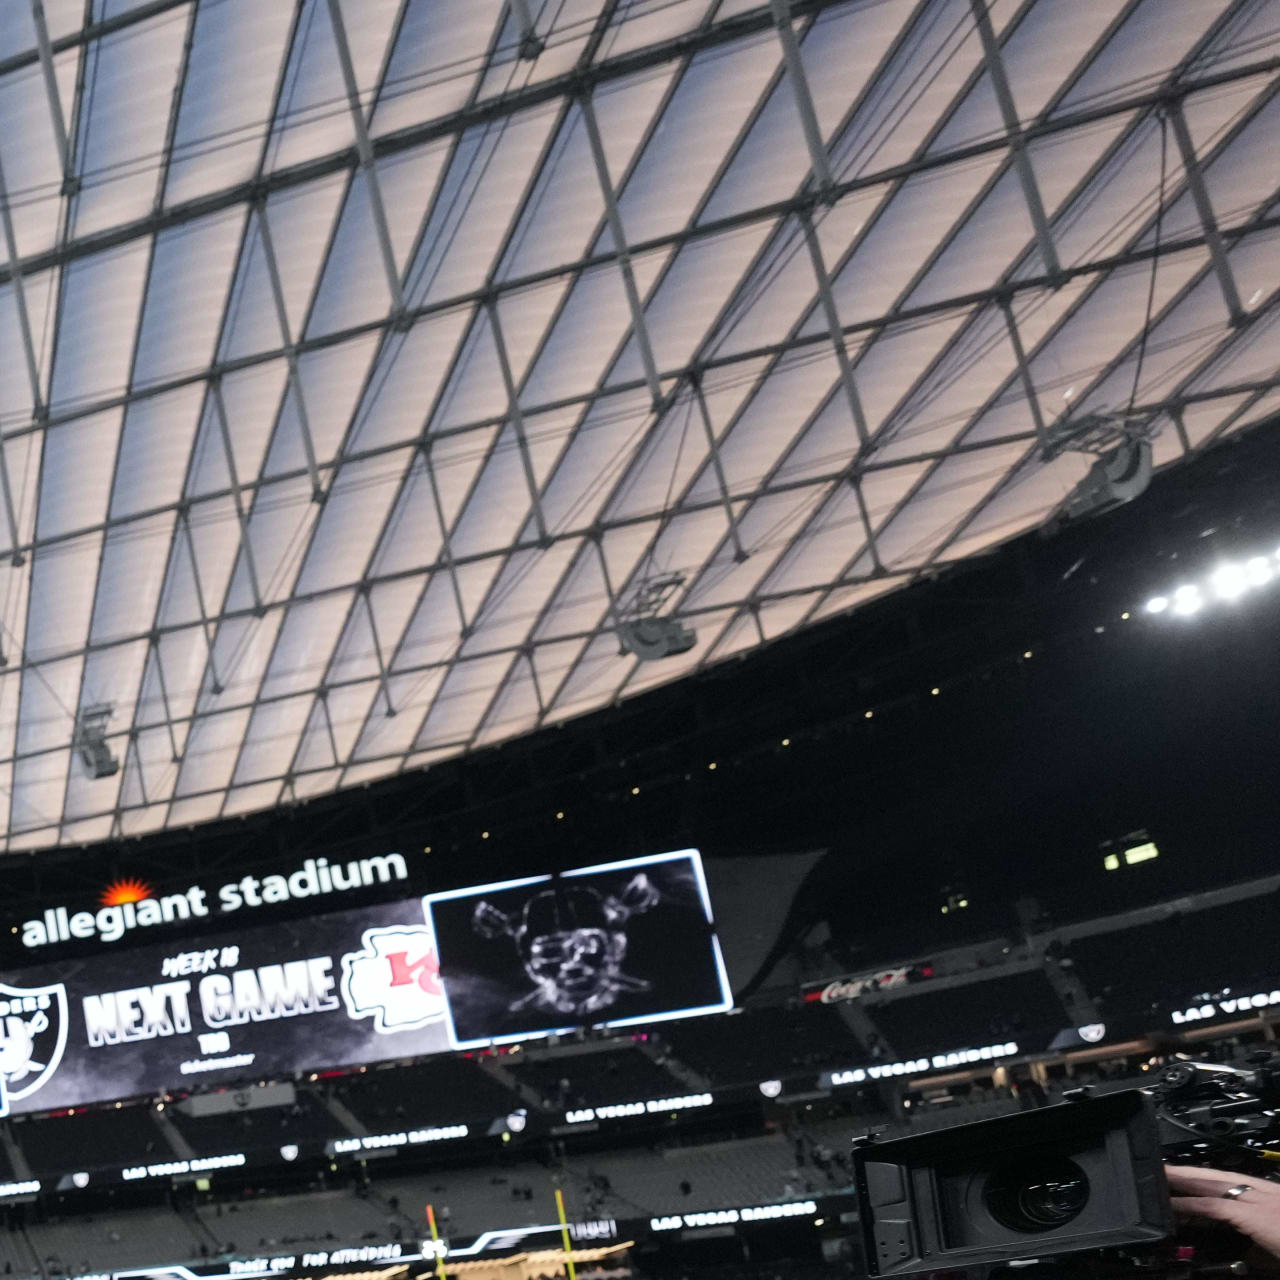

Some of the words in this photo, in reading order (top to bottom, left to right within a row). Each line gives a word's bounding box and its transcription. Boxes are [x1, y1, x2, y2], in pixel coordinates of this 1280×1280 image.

[21, 885, 208, 943] allegiant
[218, 852, 408, 913] stadium
[82, 980, 192, 1048] NEXT
[199, 956, 340, 1029] GAME
[1171, 1004, 1215, 1025] LAS
[1218, 990, 1280, 1014] VEGA
